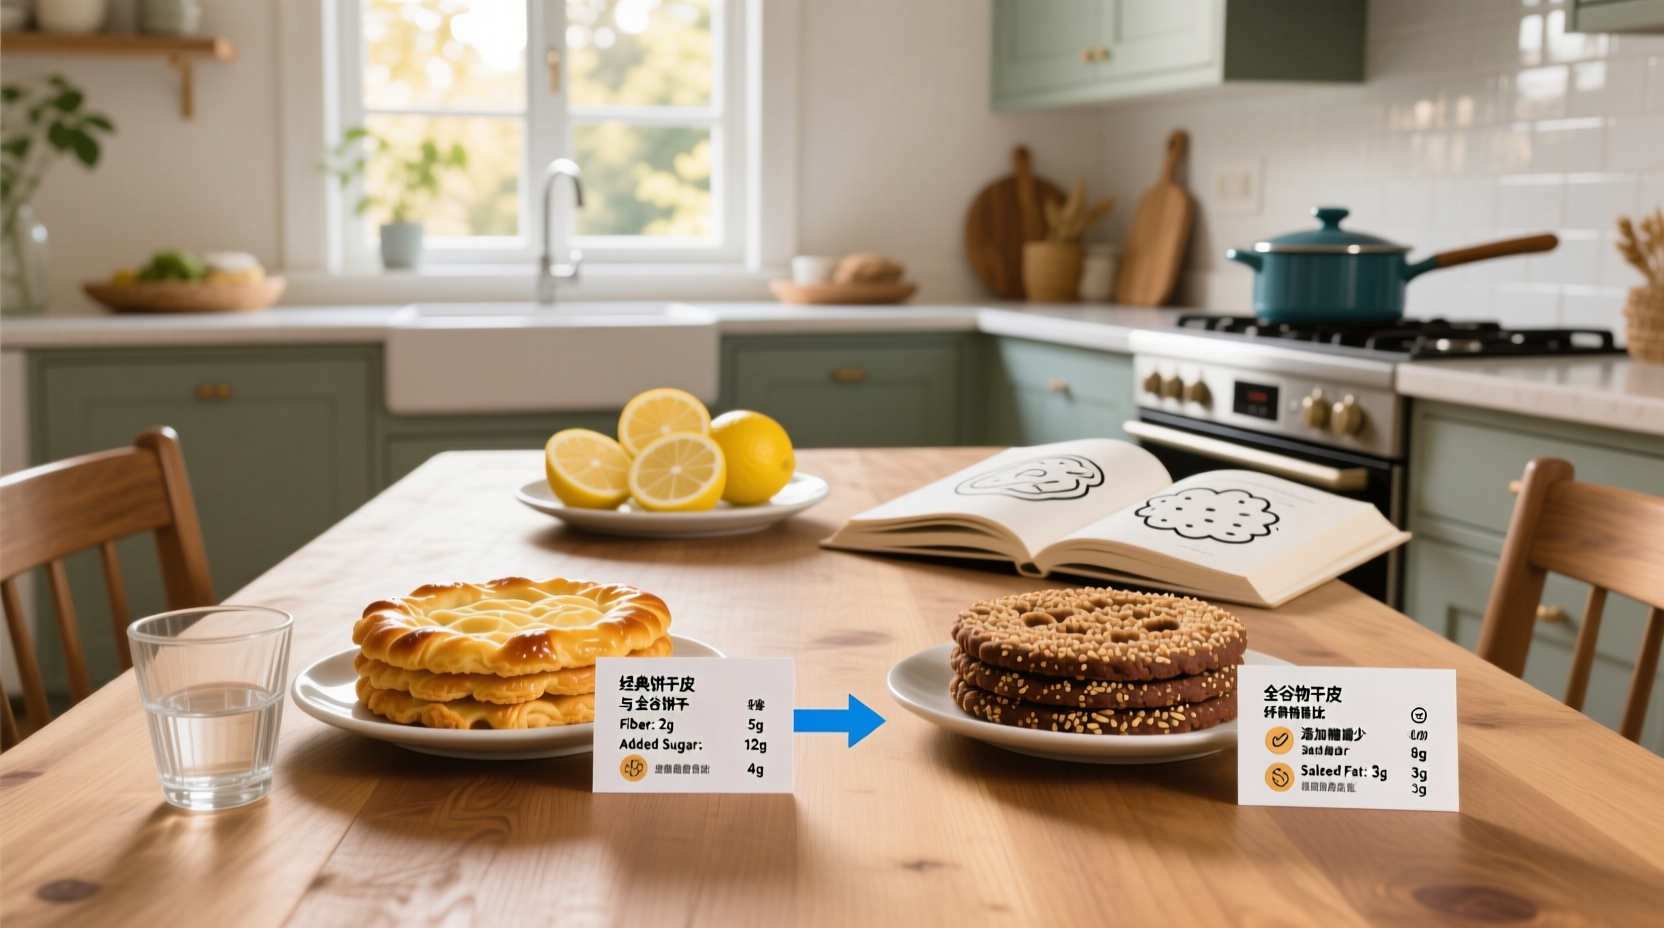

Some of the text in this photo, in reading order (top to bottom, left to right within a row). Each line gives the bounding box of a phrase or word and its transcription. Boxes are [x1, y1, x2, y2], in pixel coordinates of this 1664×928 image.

[1264, 684, 1342, 703] 全谷物干皮
[620, 718, 674, 733] Fiber: 2g
[748, 719, 764, 733] 5g
[619, 738, 703, 754] Added Sugar:
[744, 738, 767, 754] 12g
[1411, 747, 1427, 762] 8g
[747, 763, 764, 778] 4g
[1372, 765, 1388, 781] 3g
[1411, 767, 1427, 782] 3g
